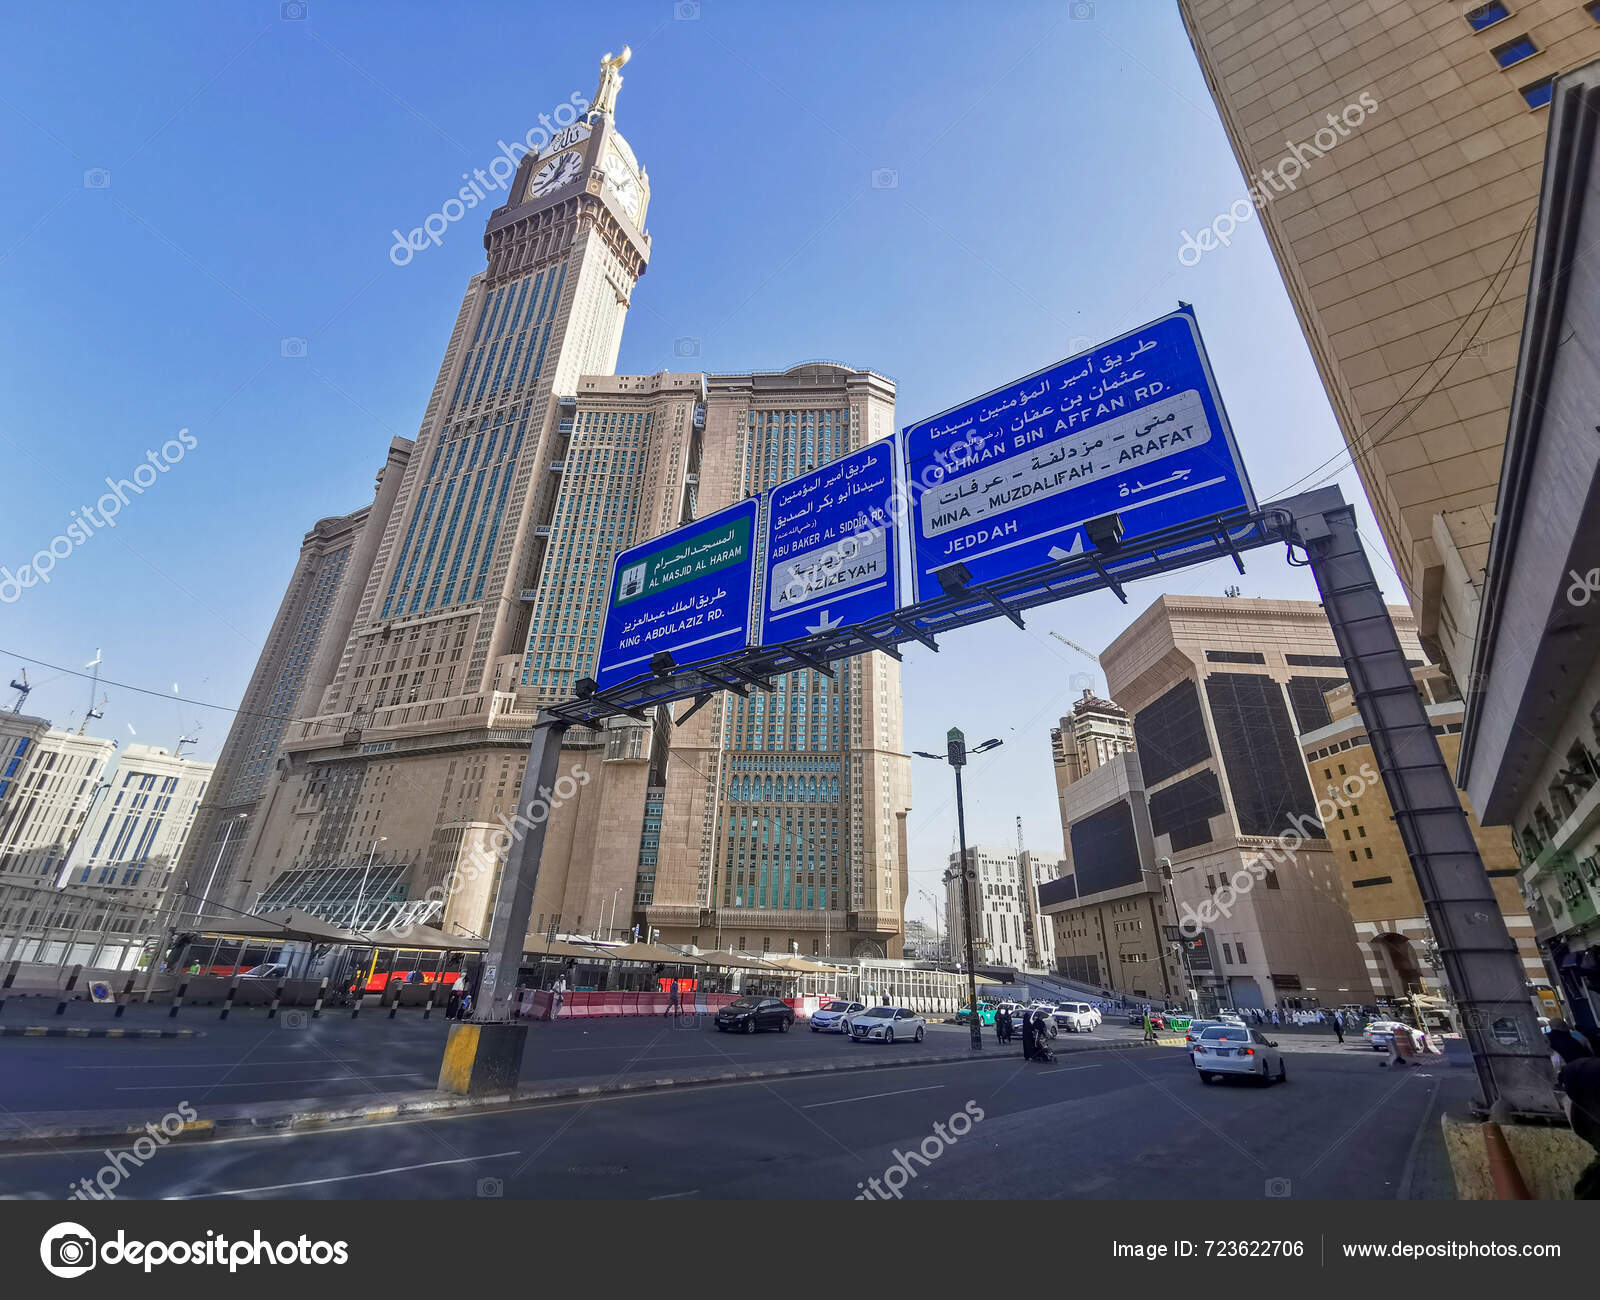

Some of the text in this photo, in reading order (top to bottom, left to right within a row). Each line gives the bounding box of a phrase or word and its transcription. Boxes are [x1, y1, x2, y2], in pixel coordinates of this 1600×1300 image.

[930, 339, 1158, 440] طريق أمير المؤمنين سيدنا
[1011, 370, 1146, 432] عثمان بن عفان
[934, 381, 1171, 479] OTHMAN BIN AFFAN RD.
[1032, 439, 1103, 471] مزدلفة
[779, 455, 878, 507] طريق أمير المؤمنين
[931, 507, 971, 530] MINA
[989, 461, 1094, 509] MUZDALIFAH
[1118, 425, 1194, 464] ARAFAT
[939, 476, 1003, 505] عرفات
[1118, 468, 1192, 498] جدة
[774, 477, 885, 530] سيدنا أبو بكر الصديق
[654, 529, 735, 574] المسجد الحرام
[772, 508, 886, 559] ABU BAKER AL SIDDIQ RD.
[944, 520, 1018, 555] JEDDAH
[648, 545, 742, 589] AL MASJID AL HARAM
[779, 560, 877, 602] AL AZIZEYAH
[667, 595, 695, 615] الملك
[696, 588, 727, 610] طريق
[619, 608, 725, 650] KING ABDULAZIZ RD.
